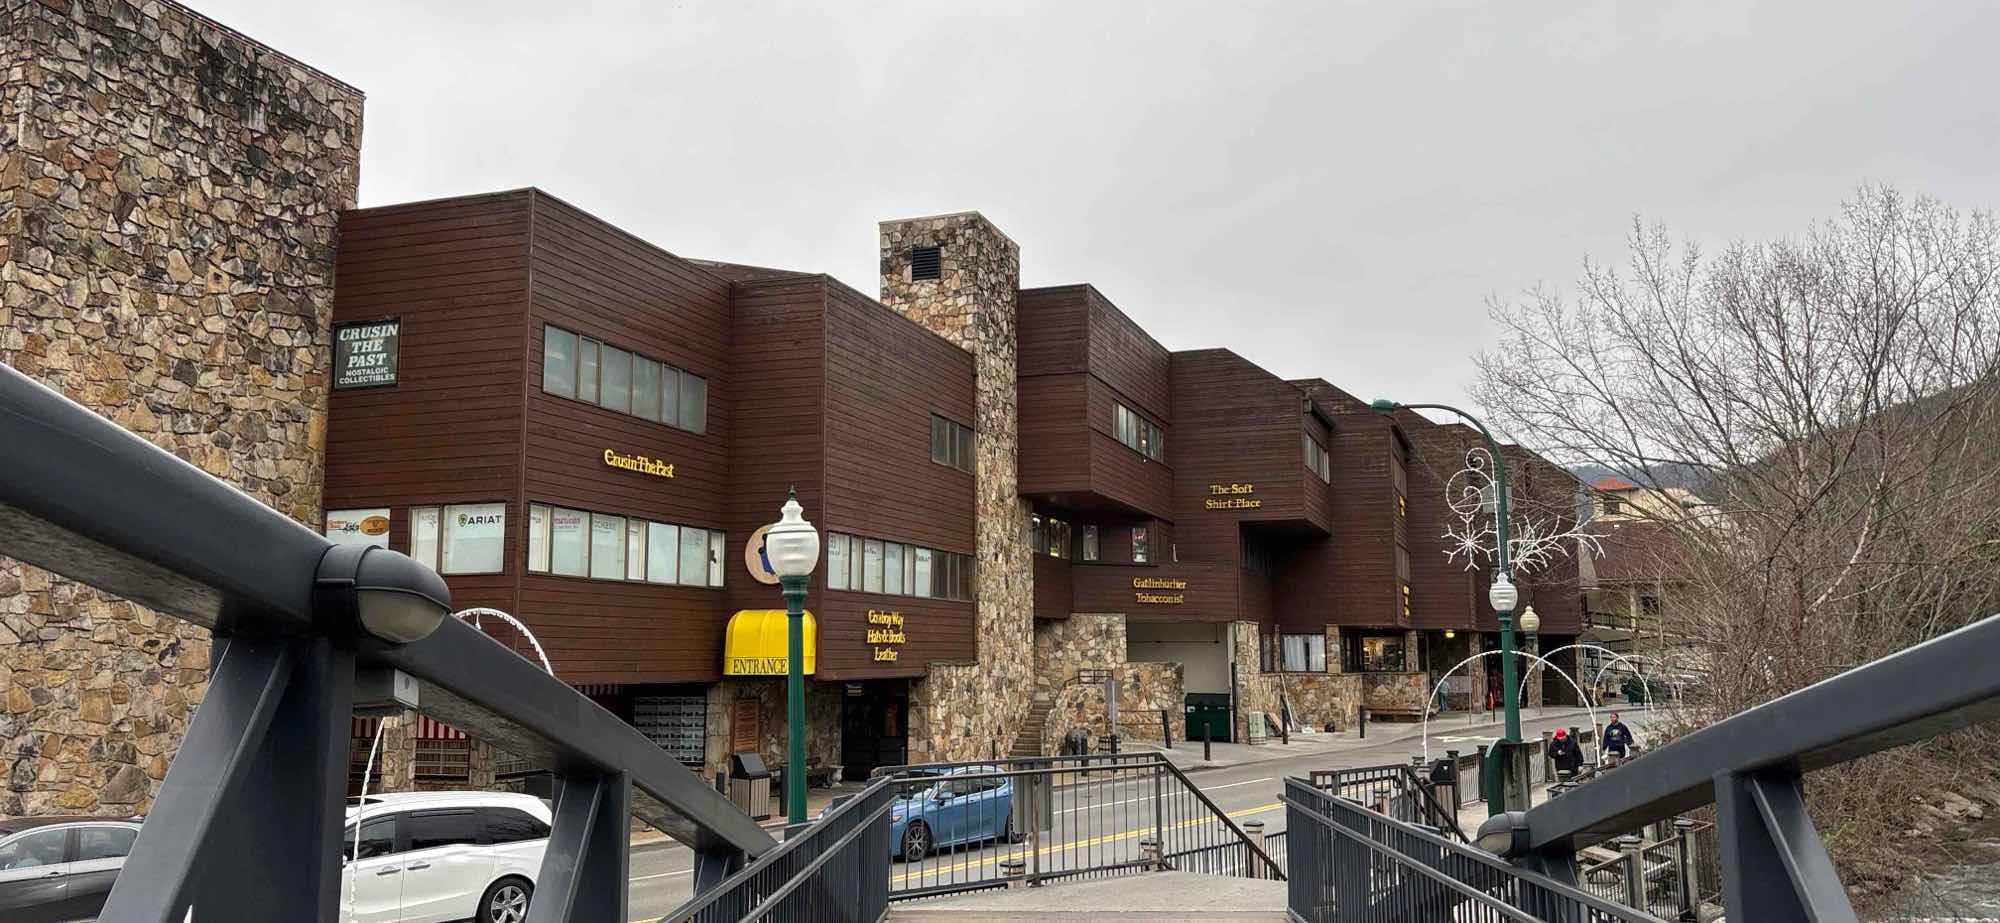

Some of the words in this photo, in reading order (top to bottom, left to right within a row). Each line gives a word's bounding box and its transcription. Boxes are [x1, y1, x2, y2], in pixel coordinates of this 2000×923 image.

[339, 324, 399, 341] CRUSIN
[351, 339, 384, 354] THE
[347, 353, 387, 368] PAST
[339, 373, 396, 384] COLLECTIBLES
[345, 367, 389, 377] NOSTALGIC
[604, 448, 637, 471] Crusin
[637, 455, 656, 474] The
[656, 459, 675, 478] Past
[1210, 484, 1230, 495] The
[1231, 483, 1254, 494] Soft
[1205, 499, 1233, 509] Shirt
[1236, 498, 1261, 508] Place
[467, 514, 502, 525] ARIAT
[1135, 592, 1184, 604] Tobacconist
[868, 609, 891, 629] Cowboy
[891, 611, 904, 630] Way
[867, 629, 881, 643] Hats
[888, 629, 906, 644] Boots
[874, 646, 898, 661] Leather
[733, 658, 788, 674] ENTRANCE
